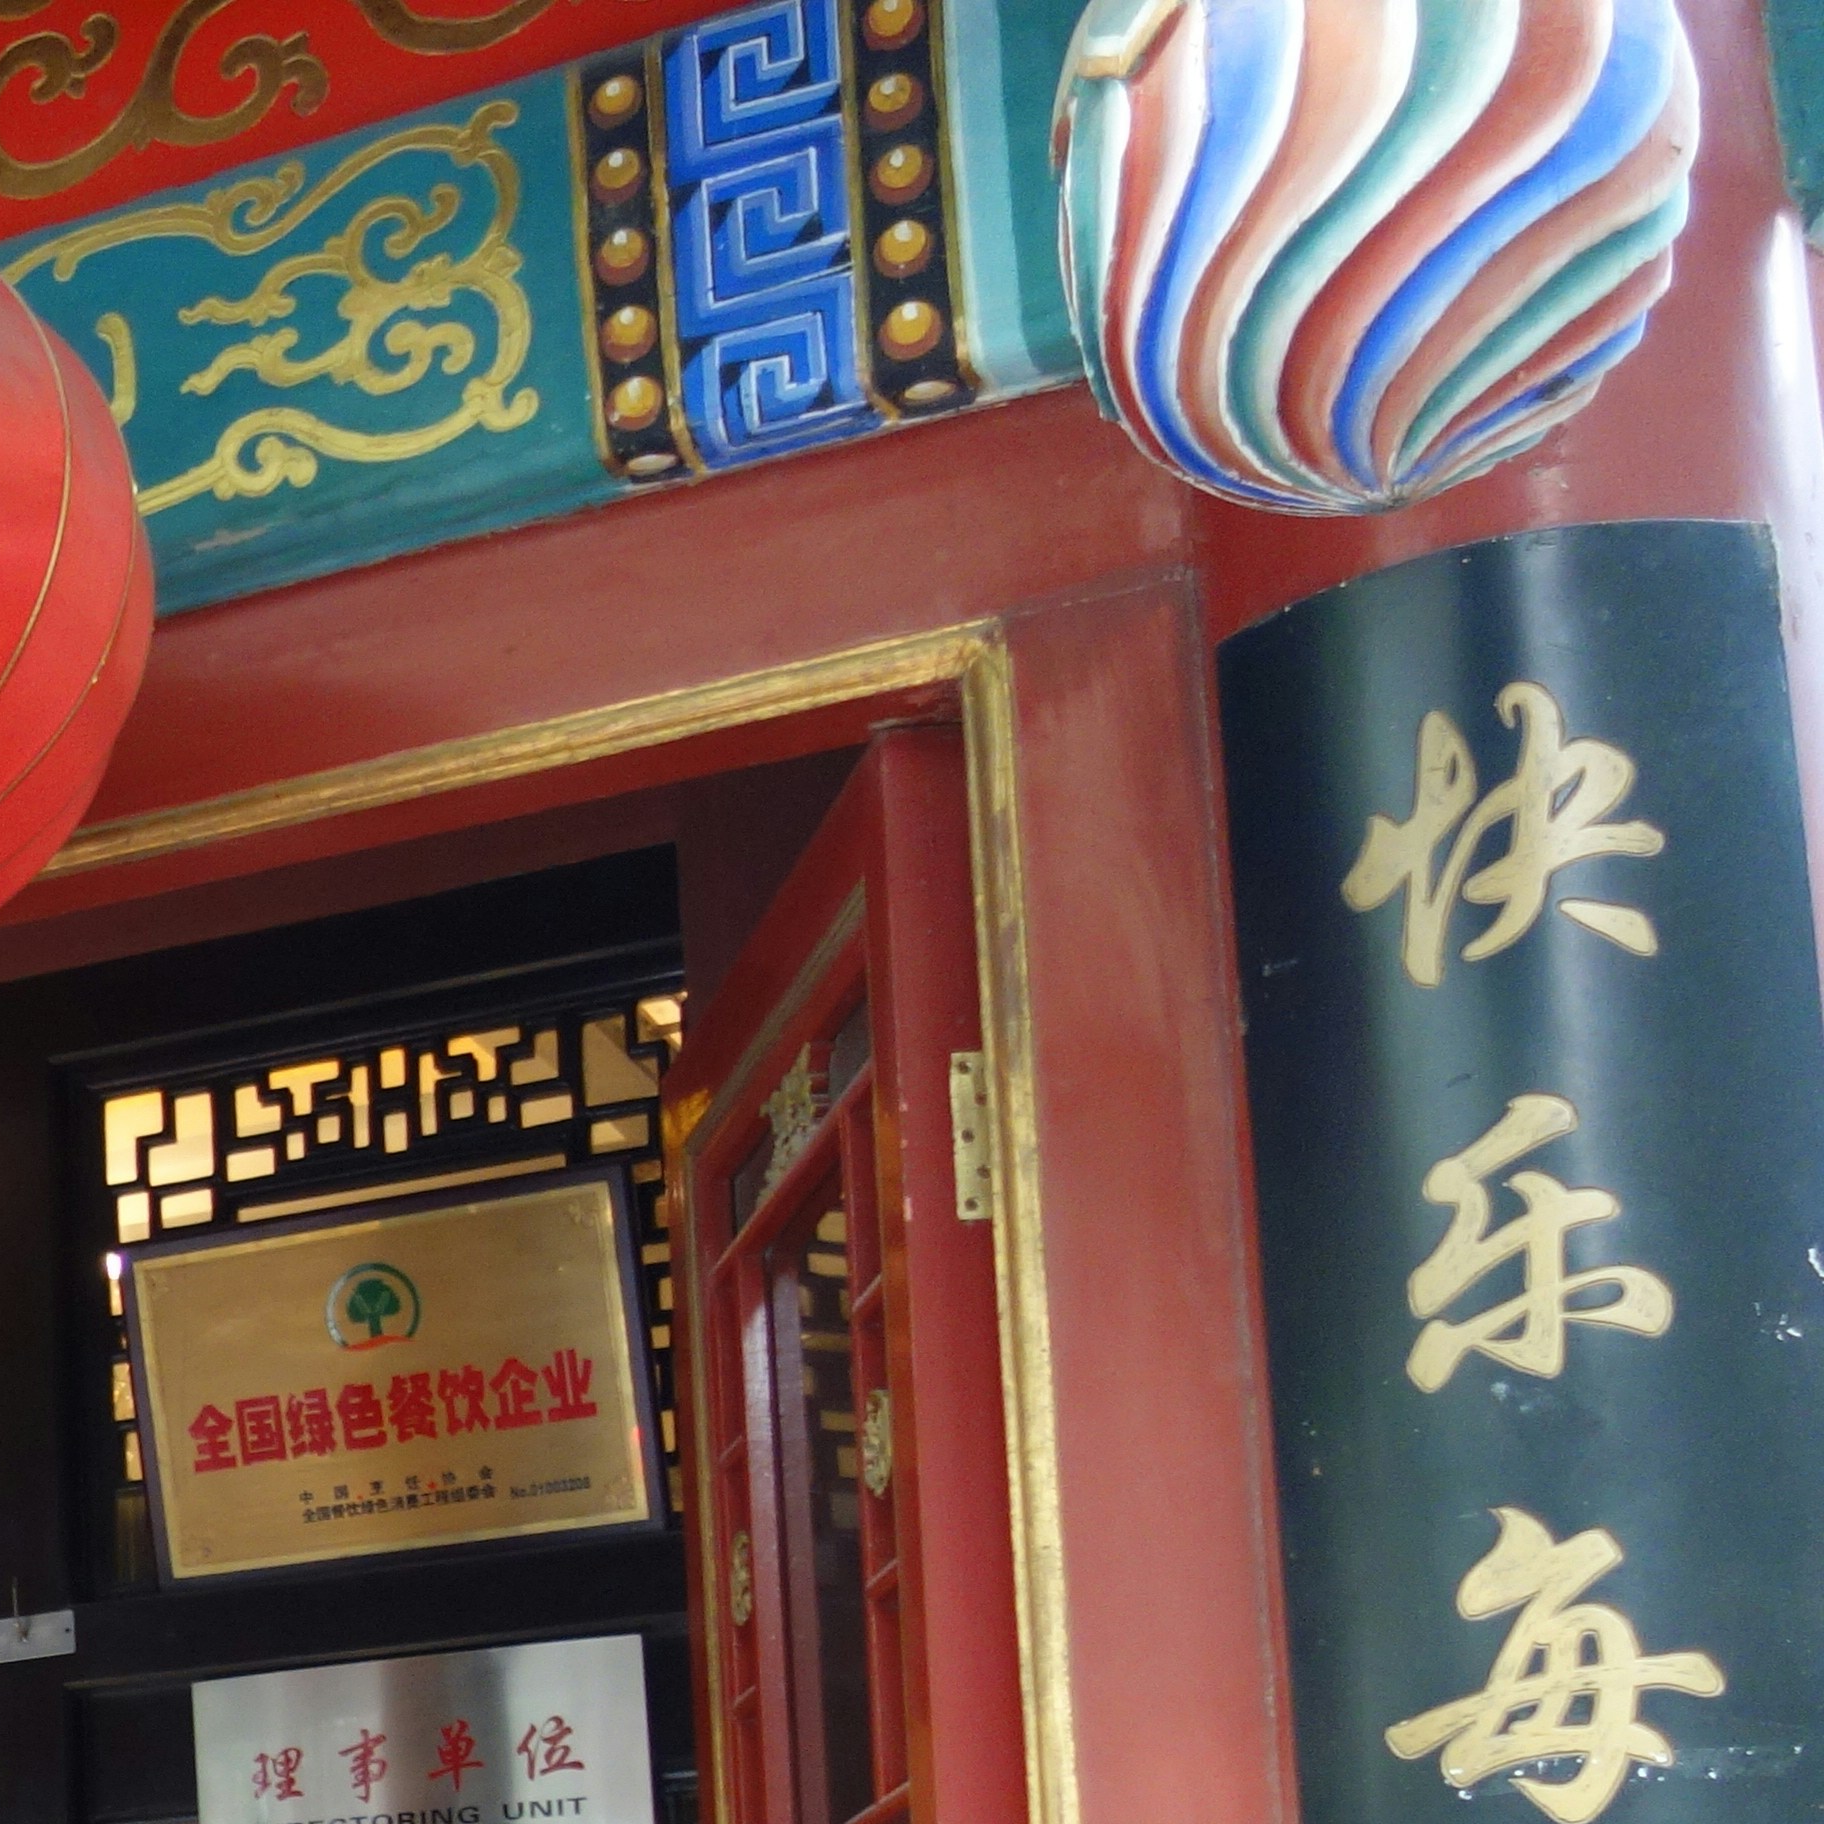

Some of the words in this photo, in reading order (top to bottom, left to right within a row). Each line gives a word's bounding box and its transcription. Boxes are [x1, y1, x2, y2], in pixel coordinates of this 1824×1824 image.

[188, 1348, 599, 1474] 全国绿色餐饮企业
[251, 1715, 586, 1803] 理事单位
[502, 1796, 588, 1821] UNIT
